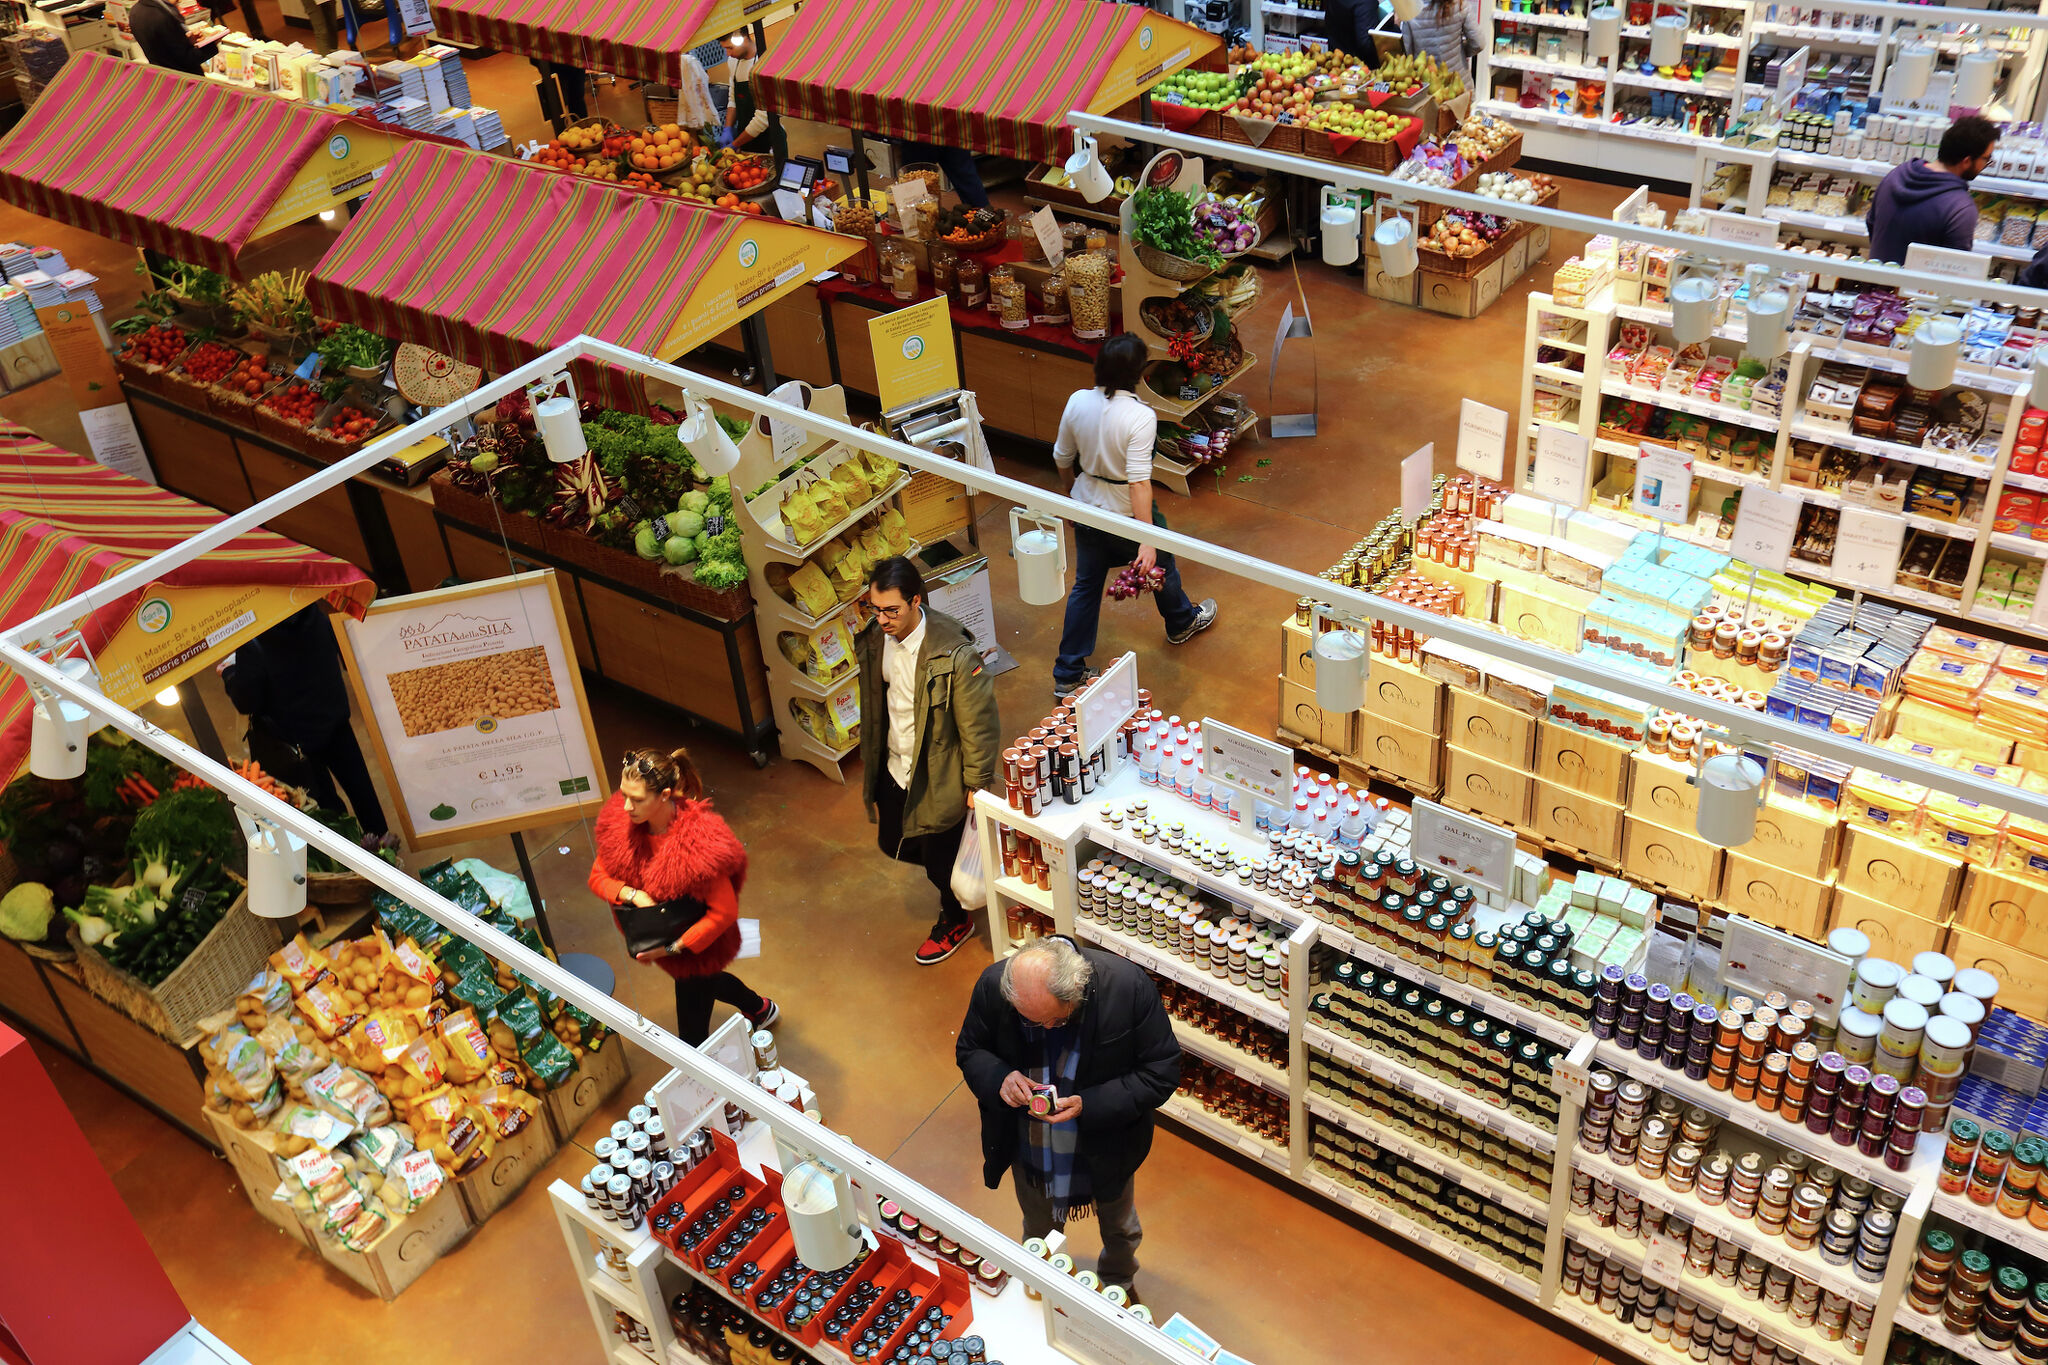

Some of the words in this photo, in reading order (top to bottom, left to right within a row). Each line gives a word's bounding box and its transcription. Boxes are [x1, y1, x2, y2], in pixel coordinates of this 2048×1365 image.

[198, 614, 215, 629] una
[216, 586, 261, 618] bioplastica
[144, 657, 180, 684] materie
[180, 641, 208, 664] prime
[208, 613, 253, 646] rinnovabili
[404, 1158, 431, 1173] Pizzoli
